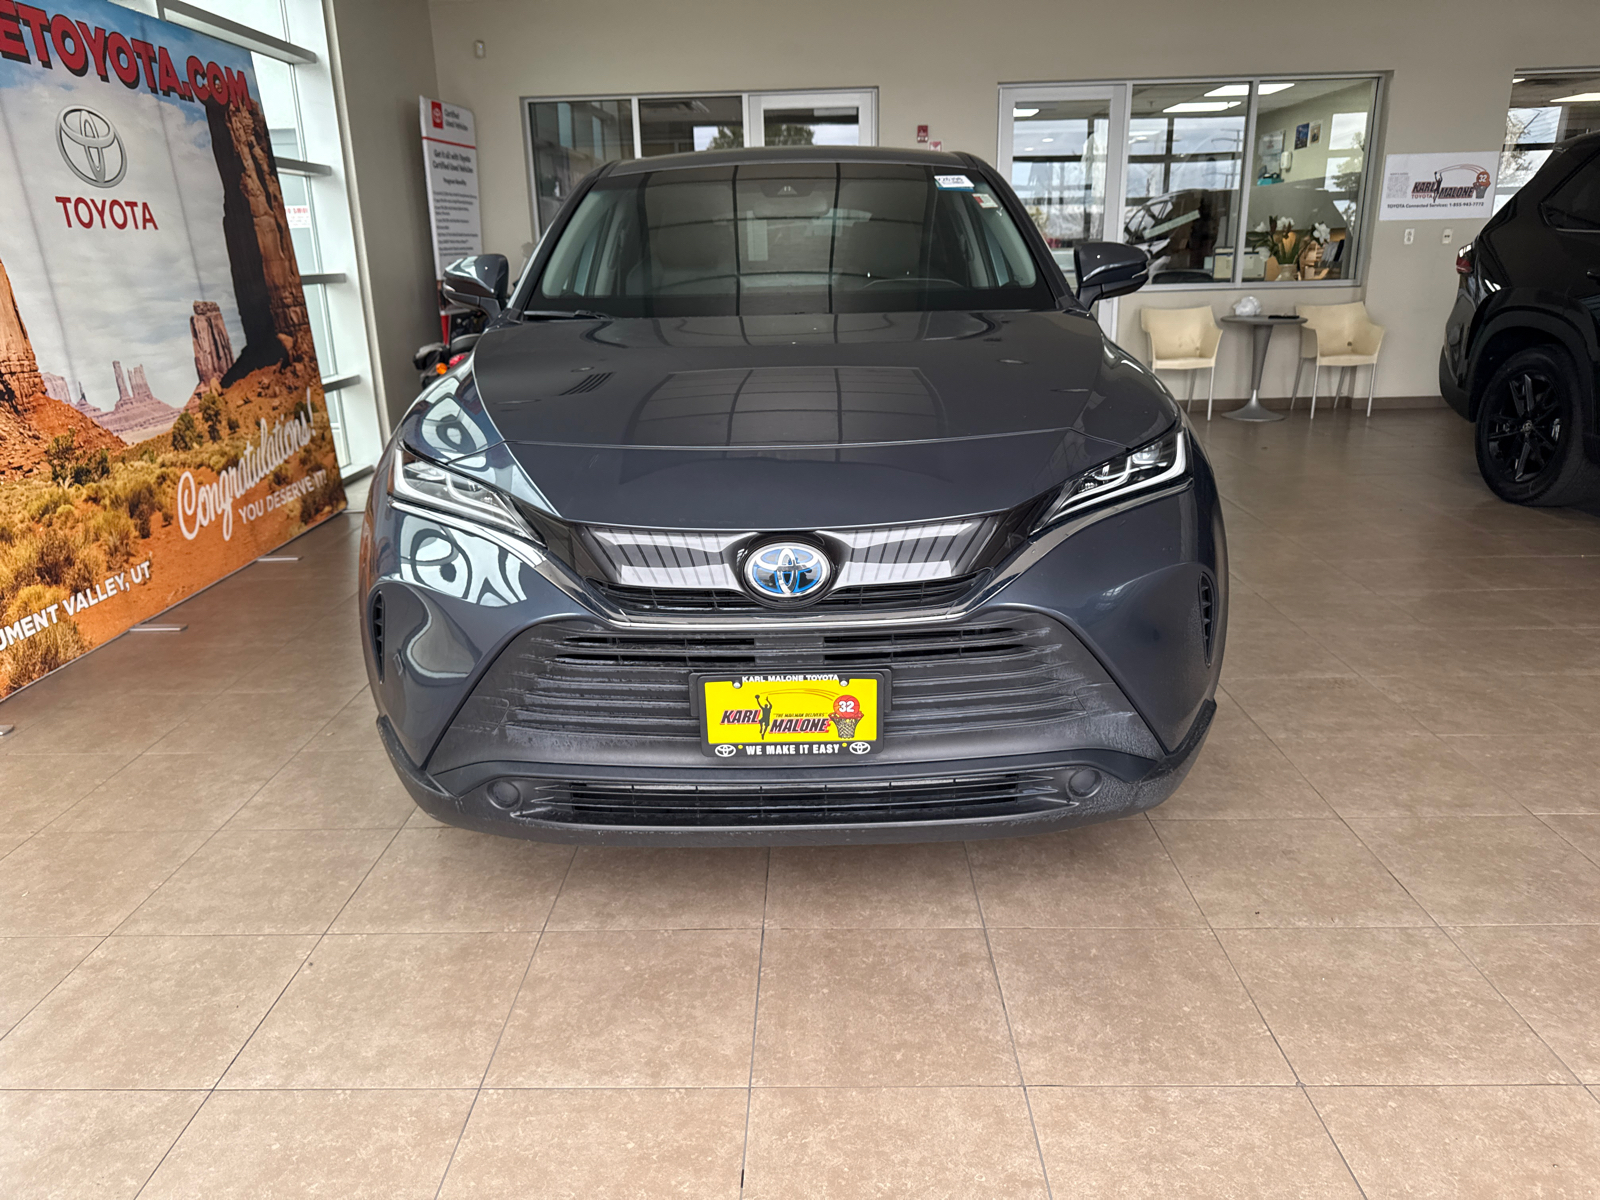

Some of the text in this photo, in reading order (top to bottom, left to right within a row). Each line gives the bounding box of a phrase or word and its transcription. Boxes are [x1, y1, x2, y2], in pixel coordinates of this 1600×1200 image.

[1412, 181, 1474, 199] KARL MALONE
[1478, 174, 1488, 183] 32
[55, 195, 159, 231] TOYOTA
[177, 386, 317, 541] Congratulations!
[238, 468, 328, 524] YOU DESERVE IT!
[62, 574, 131, 617] VALLEY,
[131, 561, 152, 584] UT
[838, 700, 855, 713] 32
[720, 709, 831, 734] KARL MALONE
[745, 743, 840, 756] WE MAKE IT EASY
